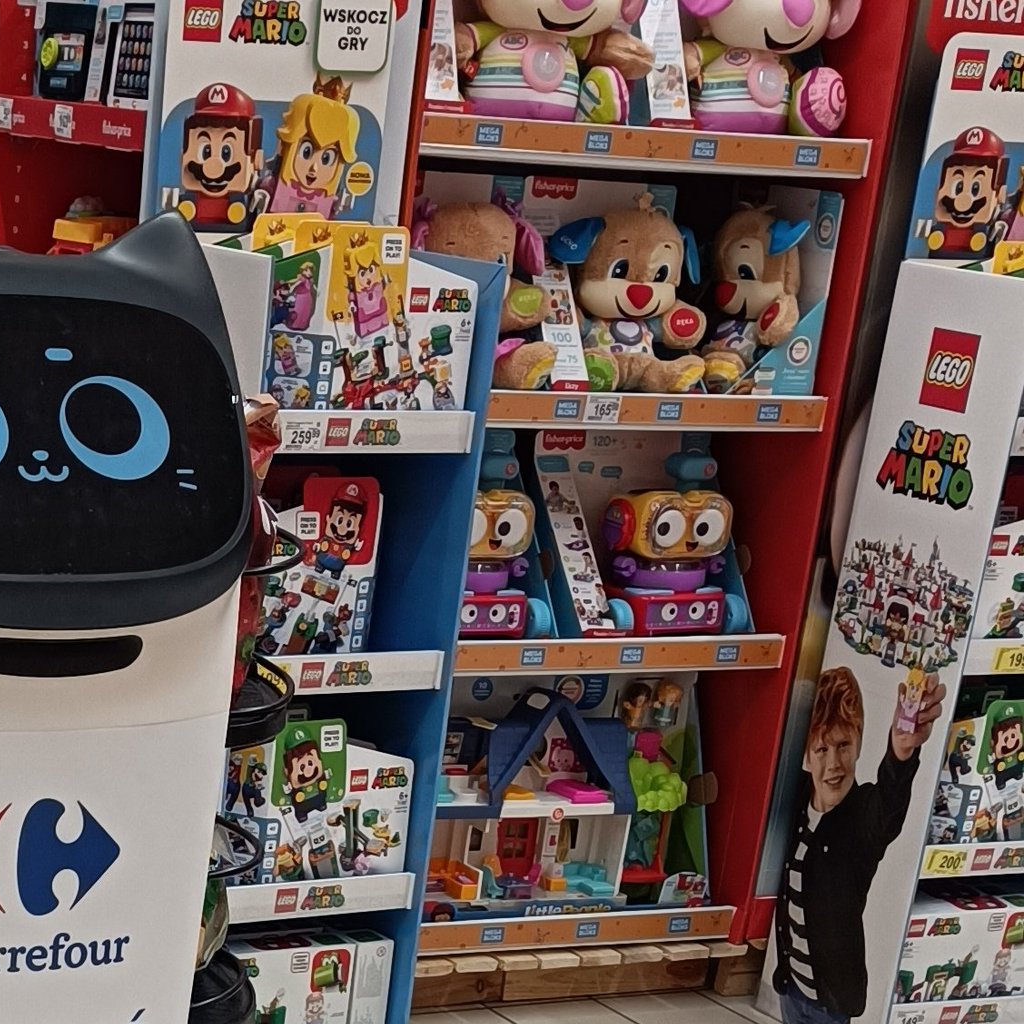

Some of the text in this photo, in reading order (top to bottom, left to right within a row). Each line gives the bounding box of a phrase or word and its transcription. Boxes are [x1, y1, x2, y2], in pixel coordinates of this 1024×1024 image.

[241, 0, 300, 19] SUPER
[323, 9, 387, 24] WSKOCZ
[186, 8, 220, 28] LEGO
[229, 16, 307, 45] MARIO
[347, 26, 361, 35] DO
[337, 37, 368, 51] GRY
[957, 62, 984, 77] LEGO
[411, 294, 428, 306] LEGO
[440, 288, 468, 299] SUPER
[432, 297, 472, 313] MARIO
[461, 319, 472, 327] 6+
[551, 332, 573, 343] 100
[928, 354, 971, 387] LEGO
[594, 403, 612, 416] 165
[362, 418, 397, 430] SUPER
[291, 430, 312, 445] 259
[329, 427, 348, 438] LEGO
[353, 429, 401, 446] MARIO
[896, 420, 971, 467] SUPER
[876, 447, 974, 511] MARIO
[272, 543, 295, 556] RIO
[303, 669, 321, 681] LEGO
[326, 670, 372, 687] MARIO
[939, 855, 961, 870] 200
